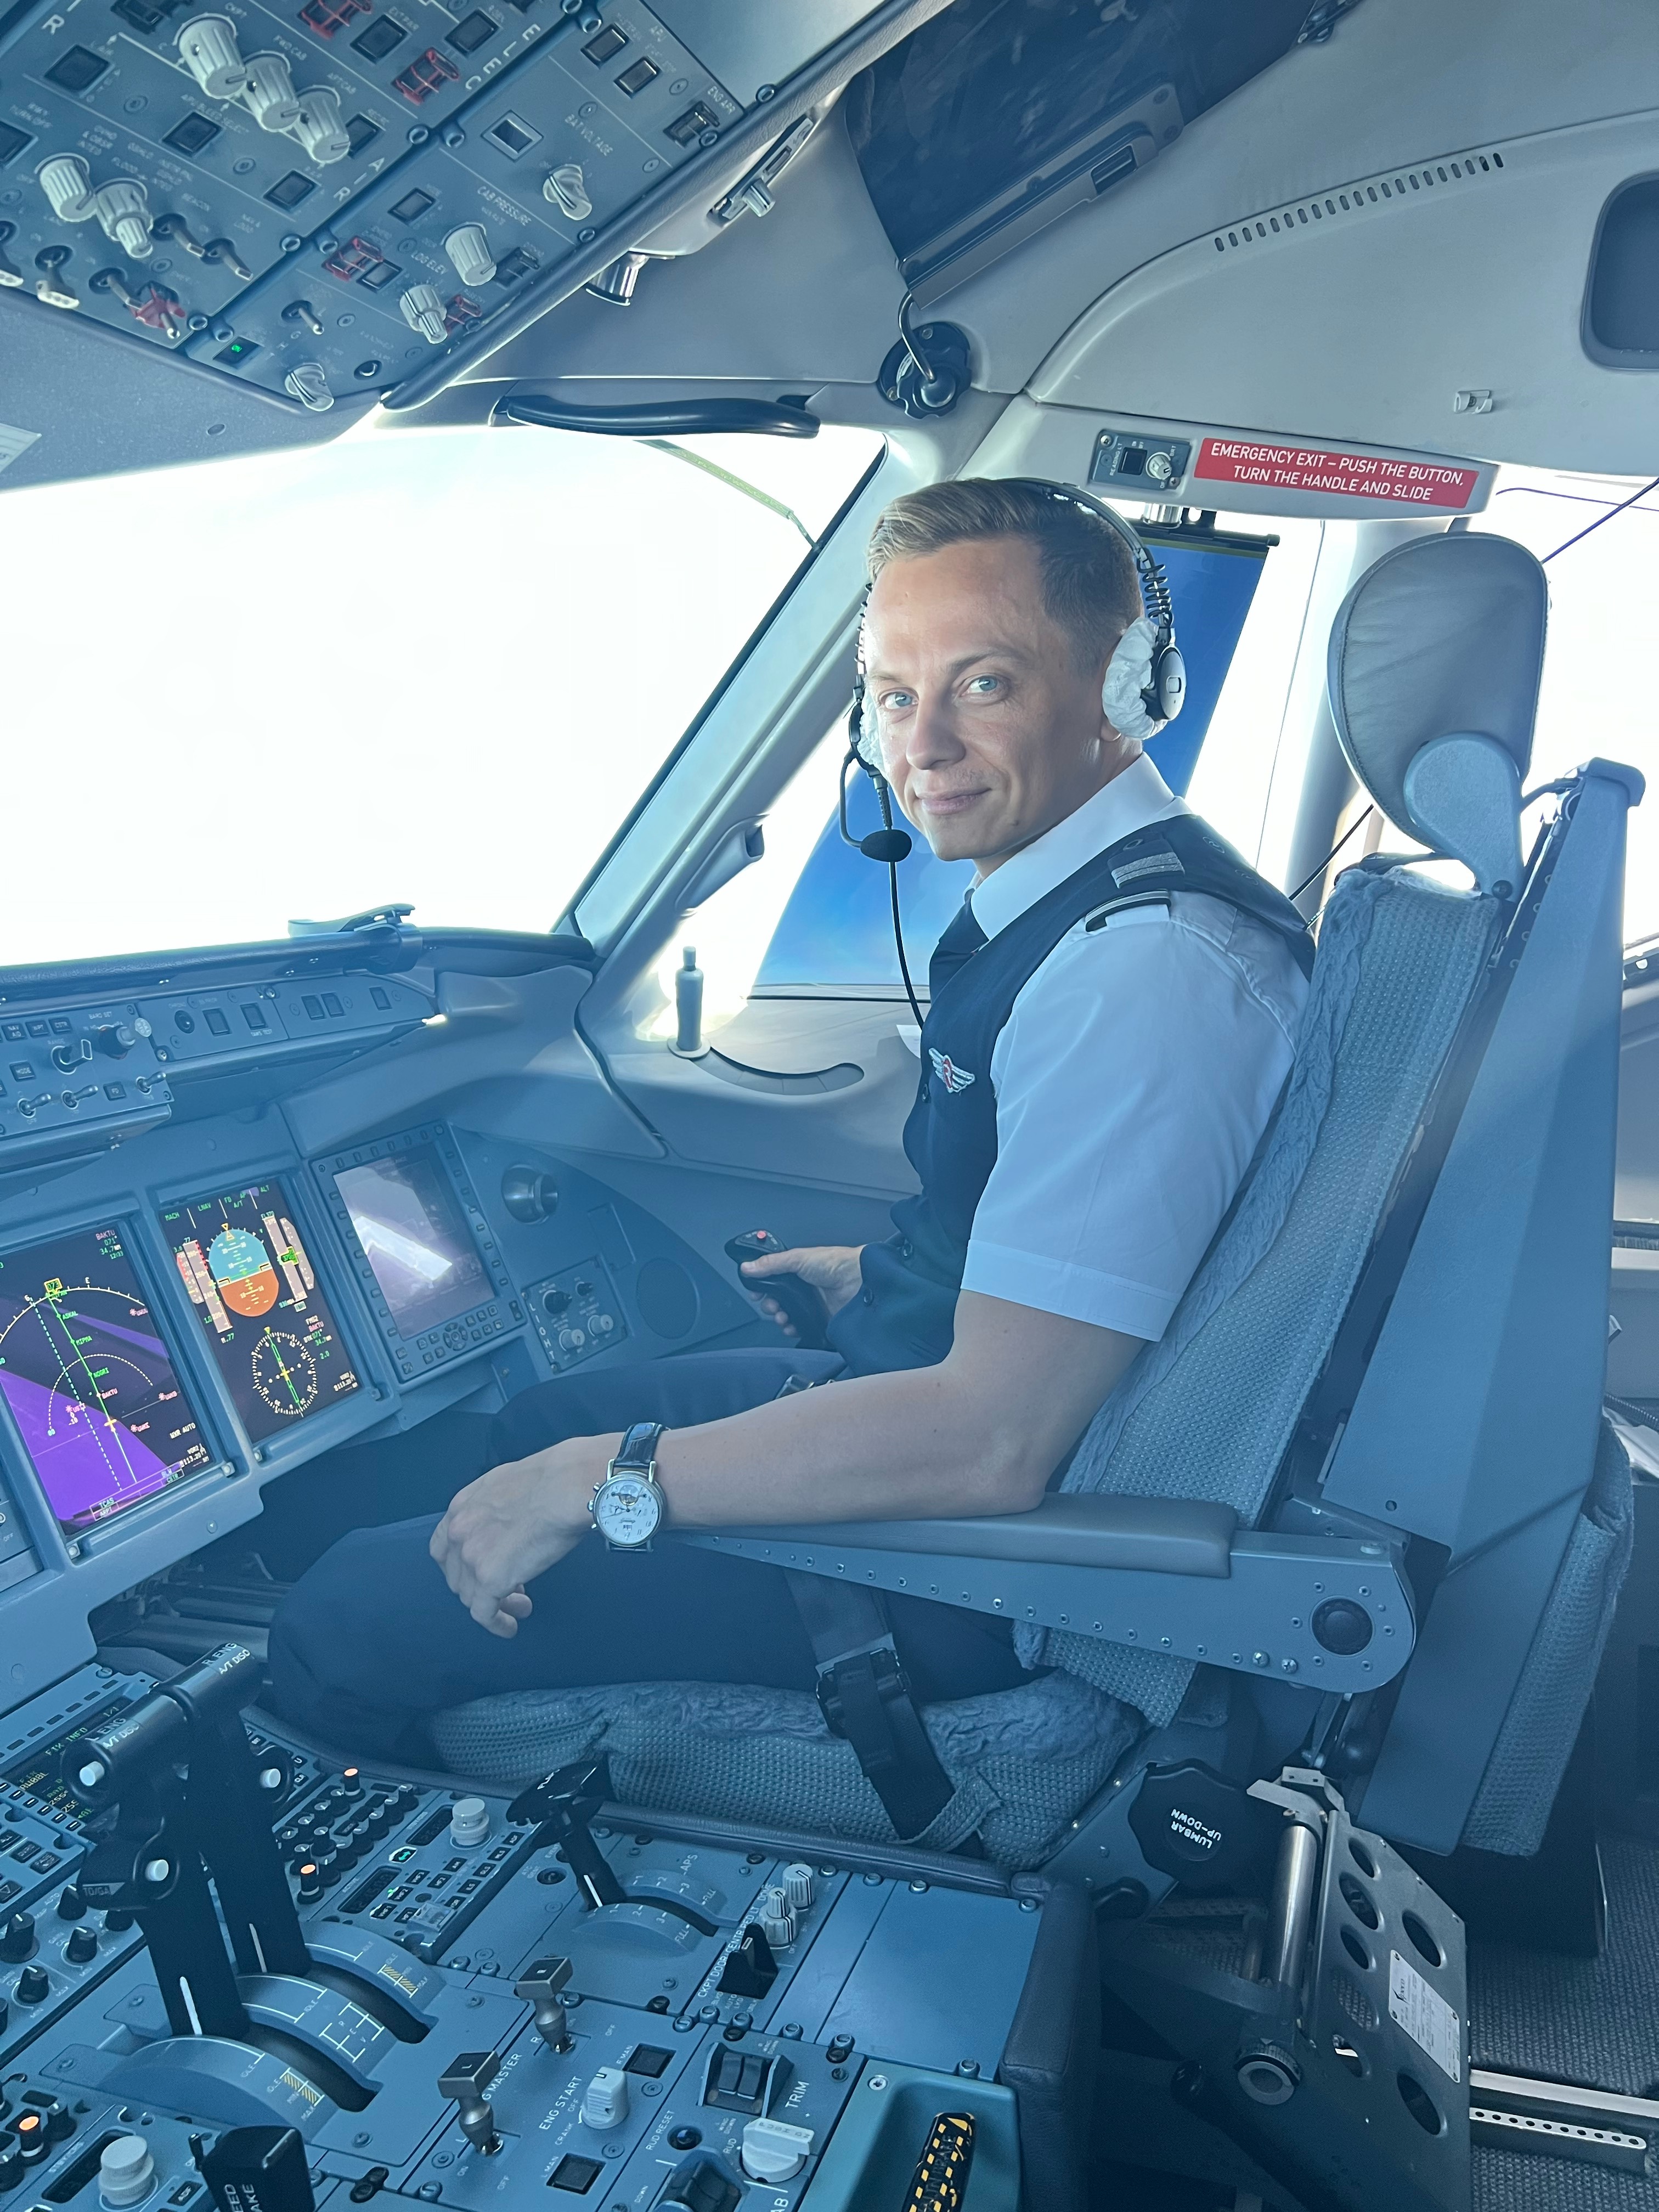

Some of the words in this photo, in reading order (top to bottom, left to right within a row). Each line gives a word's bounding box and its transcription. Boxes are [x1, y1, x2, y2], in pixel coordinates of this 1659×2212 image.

[1211, 442, 1295, 464] EMERGENCY
[1296, 453, 1327, 467] EXIT
[1339, 458, 1378, 474] PUSH
[1381, 462, 1408, 478] THE
[1234, 465, 1271, 482] TURN
[1274, 470, 1301, 484] THE
[1301, 473, 1359, 492] HANDLE
[1359, 480, 1391, 495] AND
[1392, 484, 1434, 500] SLIDE
[165, 1212, 180, 1221] MACH
[198, 1202, 212, 1212] LNAV
[224, 1196, 232, 1204] FD
[260, 1184, 270, 1193] ALT
[233, 1200, 244, 1209] A/T
[182, 1422, 196, 1434] AUTO
[98, 1497, 115, 1508] TCAS
[212, 1642, 237, 1659] ENG
[218, 1661, 233, 1674] A/T
[97, 1717, 126, 1735] ENG
[45, 1742, 65, 1756] FIX
[1171, 1809, 1222, 1841] UP-DOWN
[1171, 1821, 1213, 1849] LUMBAR
[697, 1978, 715, 1999] CKPT
[709, 1954, 730, 1978] DOOR
[303, 1999, 318, 2013] IDLE
[725, 1994, 737, 2010] AUTO
[530, 2036, 542, 2044] R
[488, 2053, 523, 2092] MASTER
[539, 2109, 560, 2130] ENG
[555, 2075, 583, 2108] START
[785, 2081, 810, 2108] TRIM
[568, 2099, 579, 2112] OFF
[555, 2123, 574, 2146] CRANK
[645, 2134, 661, 2151] RUD
[655, 2109, 675, 2136] RESET
[722, 2137, 737, 2155] RUD
